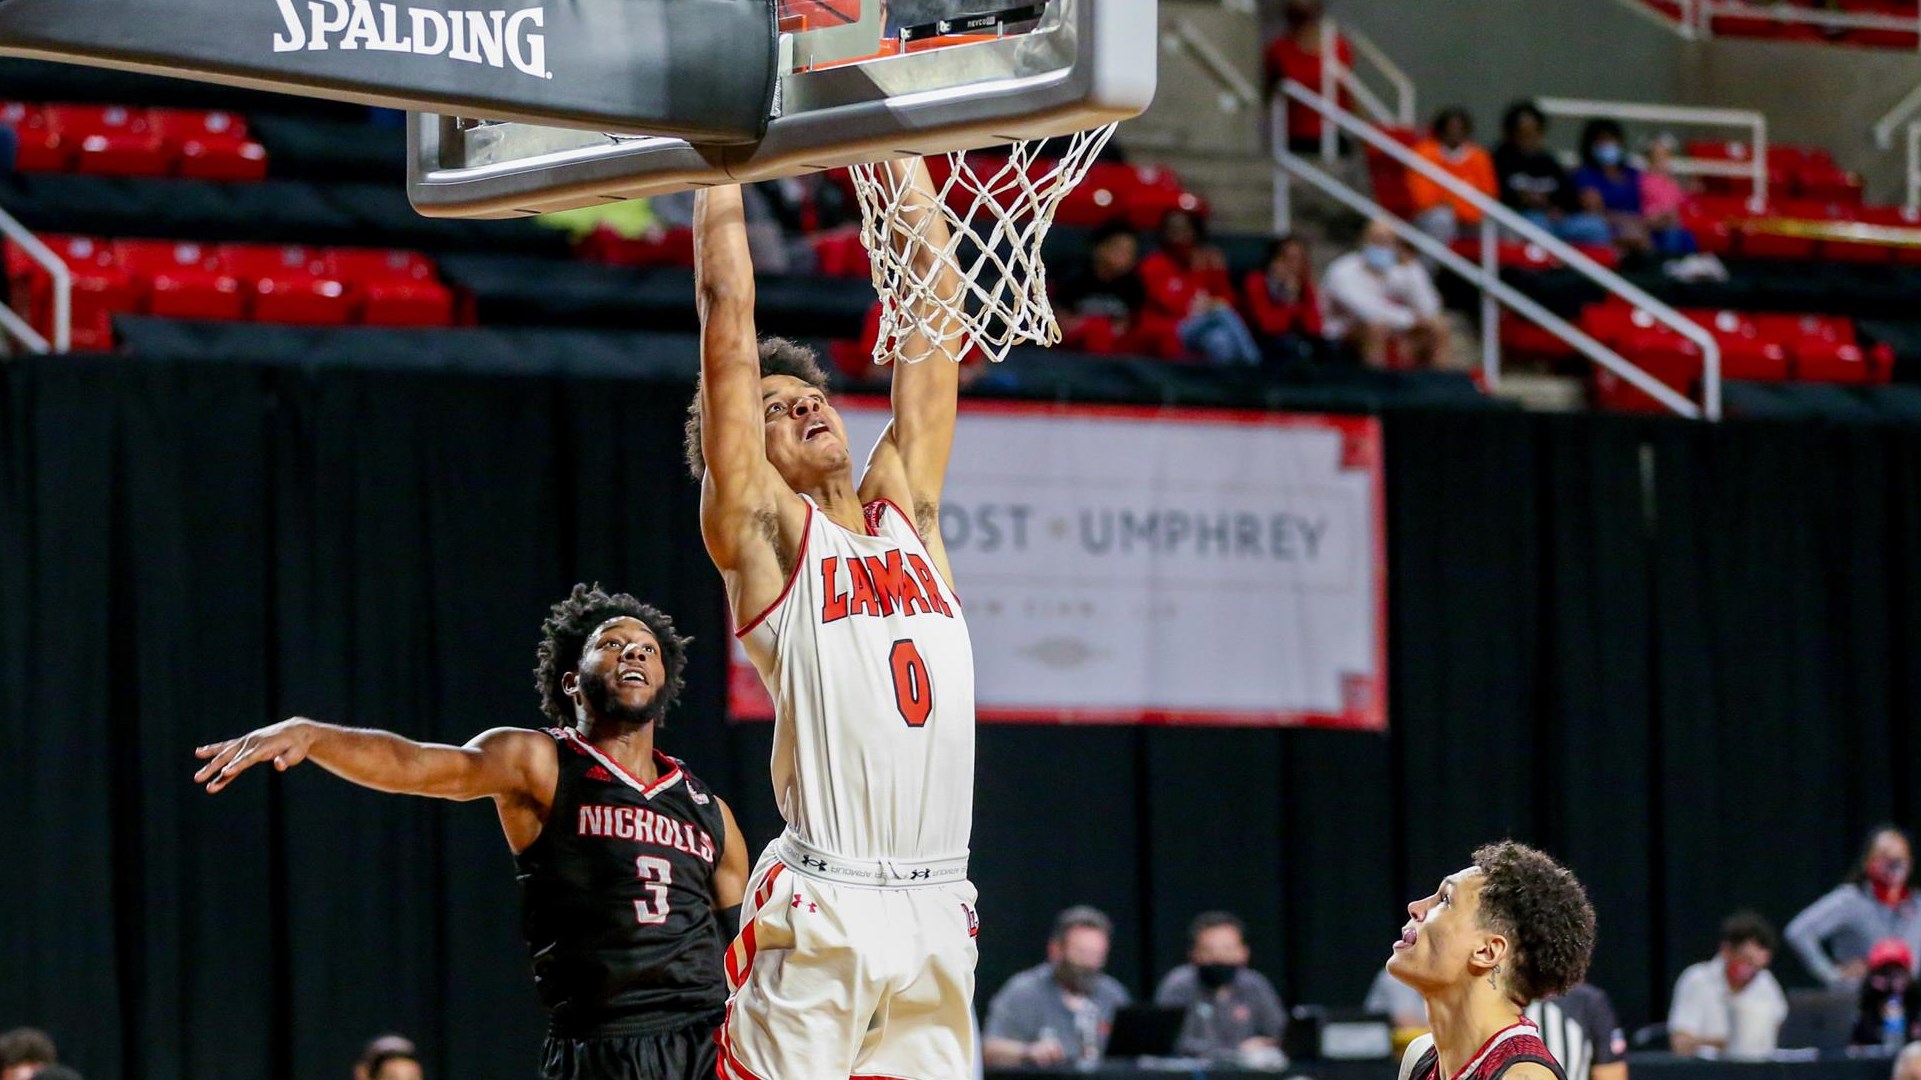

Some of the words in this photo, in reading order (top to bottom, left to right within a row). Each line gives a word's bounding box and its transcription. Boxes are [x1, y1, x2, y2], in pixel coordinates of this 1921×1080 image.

[274, 0, 546, 78] SPALDING
[940, 504, 1033, 553] OST
[1078, 508, 1330, 560] UMPHREY
[821, 548, 954, 624] LAMAR
[888, 638, 933, 728] 0
[578, 803, 716, 865] NICHOLLS
[633, 854, 672, 925] 3
